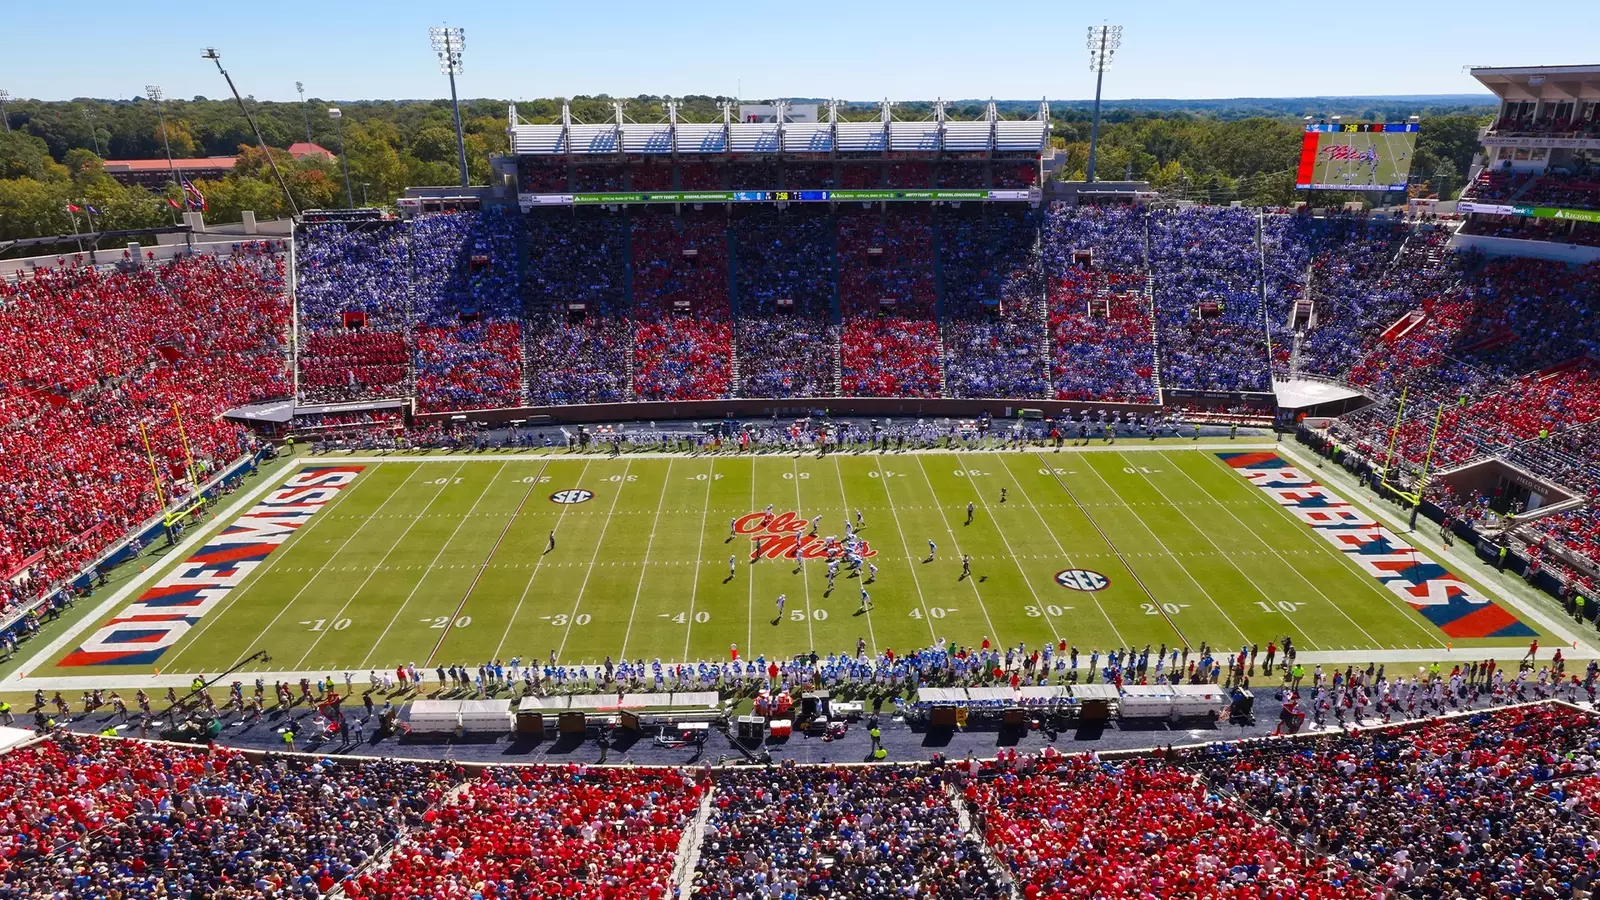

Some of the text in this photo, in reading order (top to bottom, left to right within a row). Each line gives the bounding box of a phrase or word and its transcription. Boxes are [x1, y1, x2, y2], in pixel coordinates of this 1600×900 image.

[1564, 211, 1592, 220] REGIONS
[551, 490, 593, 504] SEC
[734, 511, 809, 534] Ole
[1232, 466, 1491, 605] REBELS
[79, 471, 360, 652] OLE MISS
[1057, 569, 1108, 591] SEC
[908, 607, 946, 619] 40
[1024, 604, 1064, 617] 30
[1140, 602, 1181, 615] 20
[1253, 600, 1297, 613] 10
[552, 613, 592, 625] 30
[671, 611, 711, 624] 40
[790, 609, 828, 621] 50
[307, 617, 352, 631] 10
[429, 616, 472, 629] 20
